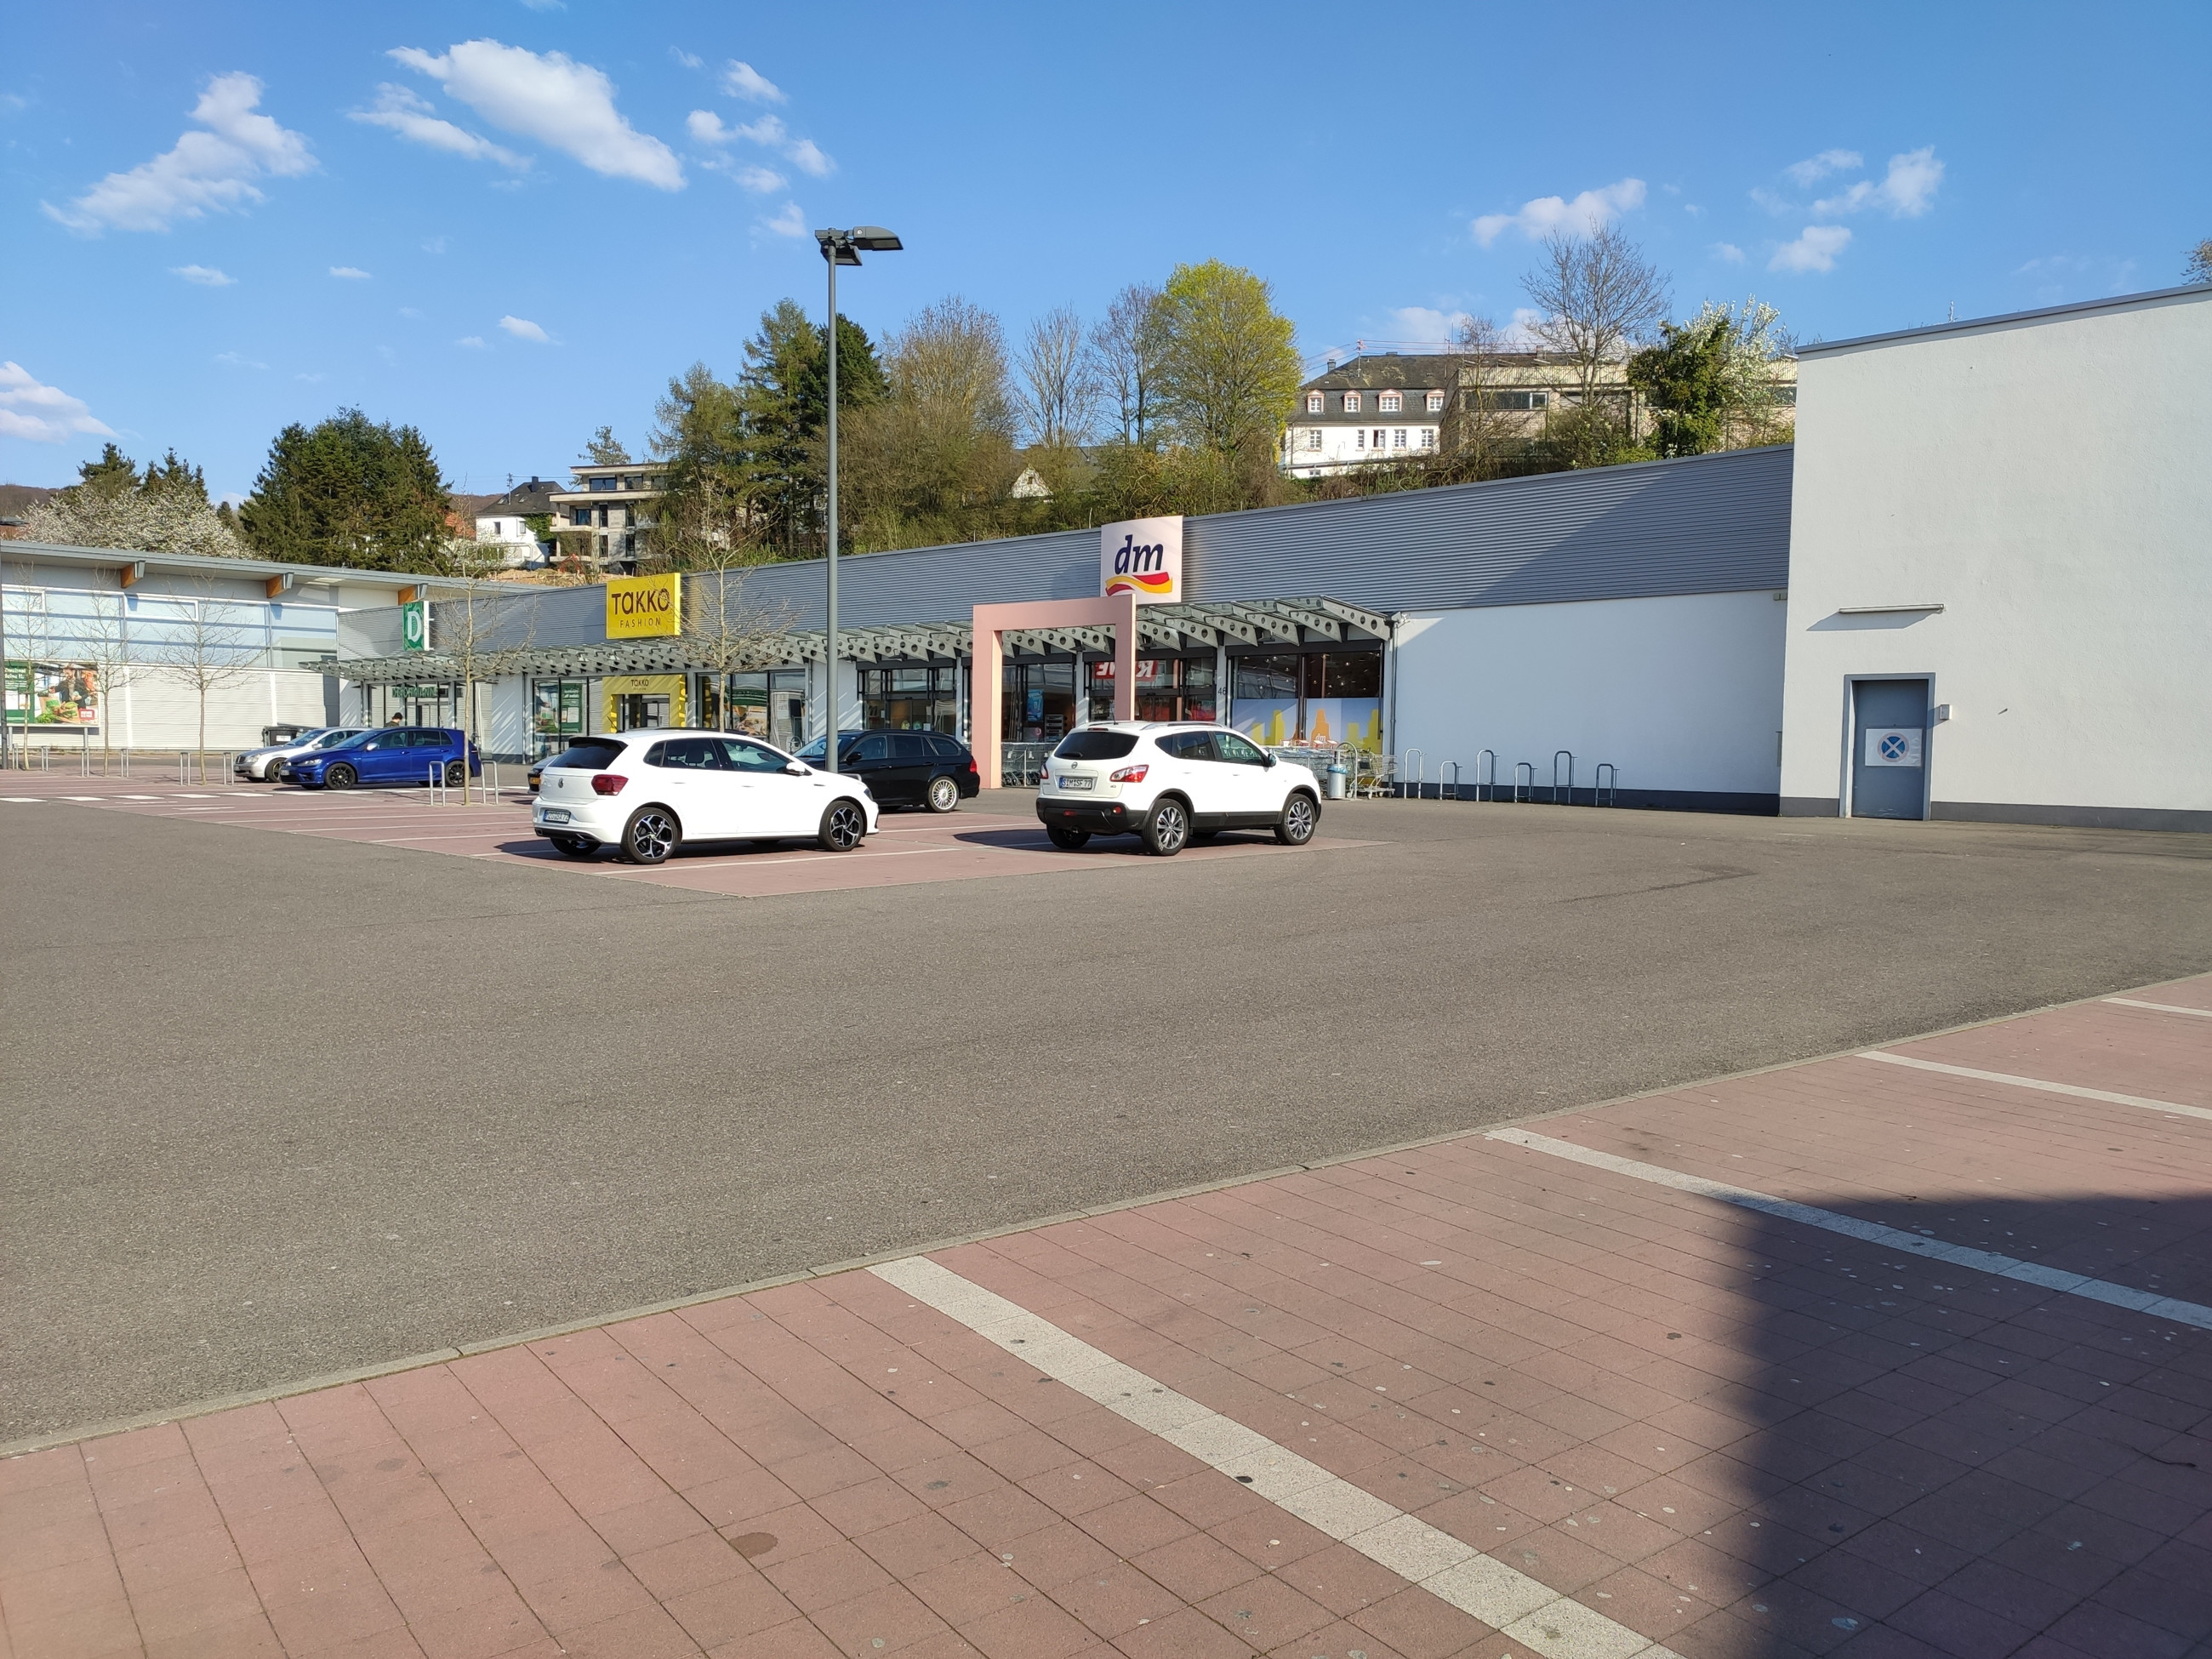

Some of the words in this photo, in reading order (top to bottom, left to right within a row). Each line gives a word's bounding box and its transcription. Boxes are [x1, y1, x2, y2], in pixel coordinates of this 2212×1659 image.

[1115, 534, 1164, 575] dm
[407, 610, 422, 642] D
[619, 617, 662, 629] FASHION
